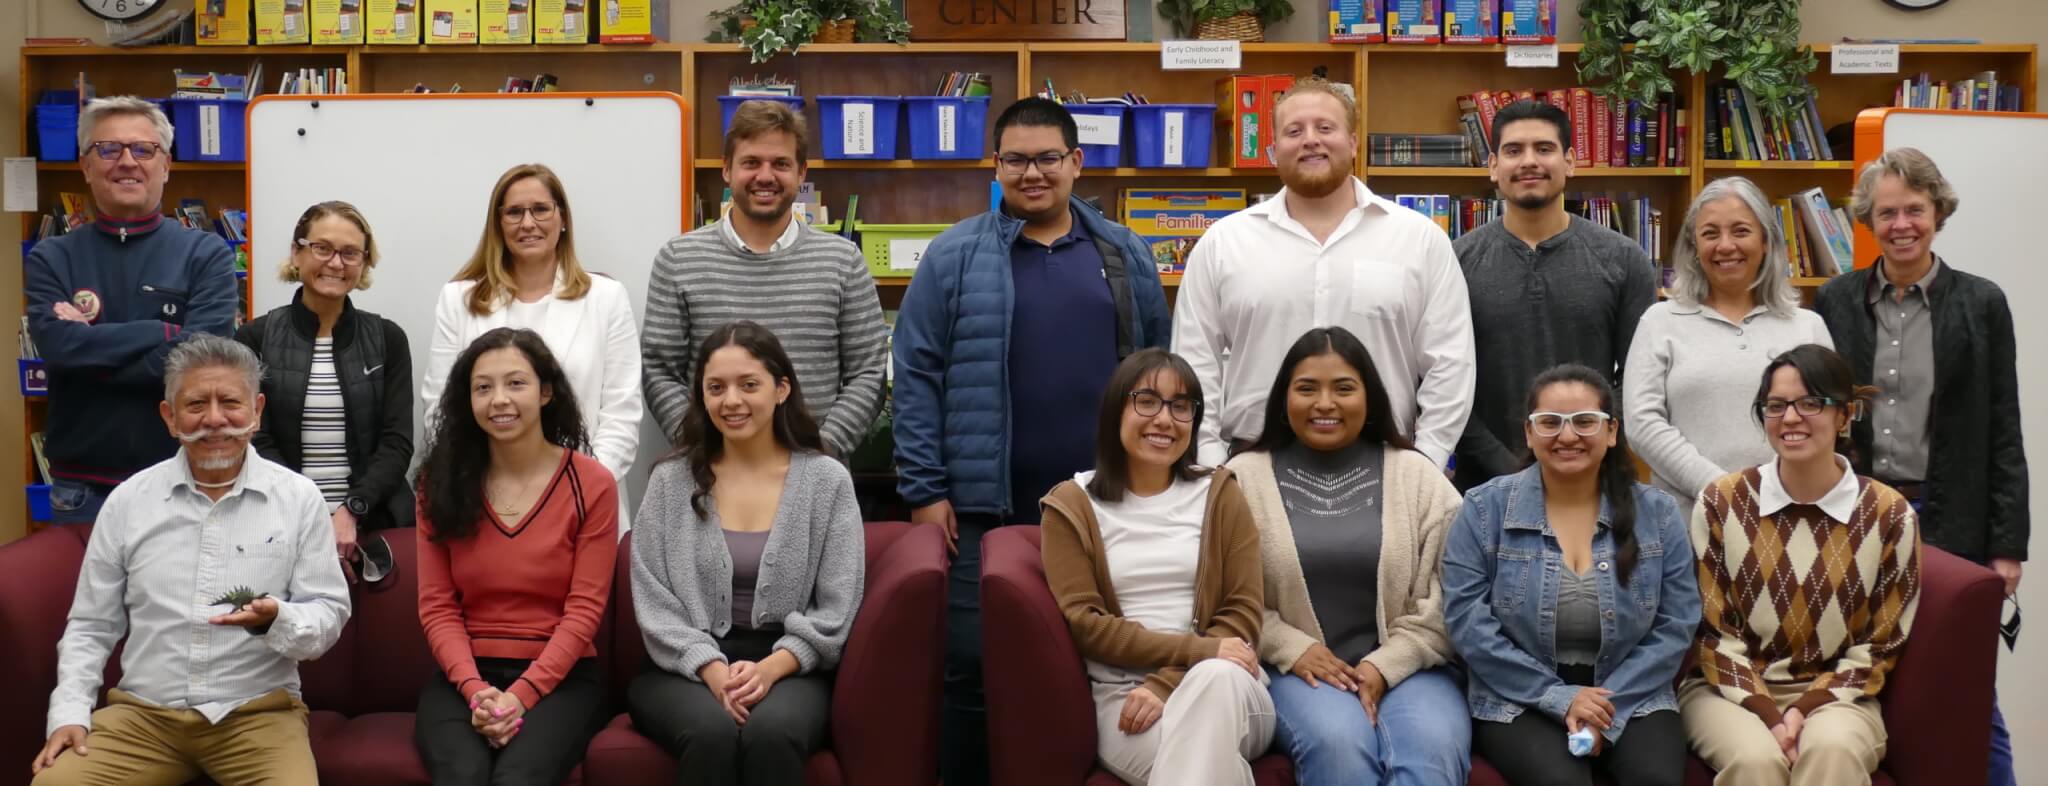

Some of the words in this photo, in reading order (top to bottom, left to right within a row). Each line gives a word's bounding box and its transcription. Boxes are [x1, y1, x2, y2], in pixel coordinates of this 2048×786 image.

[116, 0, 127, 12] 6
[939, 0, 1099, 25] CENTER
[1167, 46, 1184, 55] Early
[1185, 45, 1218, 53] Childhood
[1514, 51, 1553, 59] Dictionaries
[1838, 48, 1880, 56] Professional
[1175, 57, 1197, 65] Family
[1198, 56, 1225, 65] Literacy
[858, 111, 866, 137] Science
